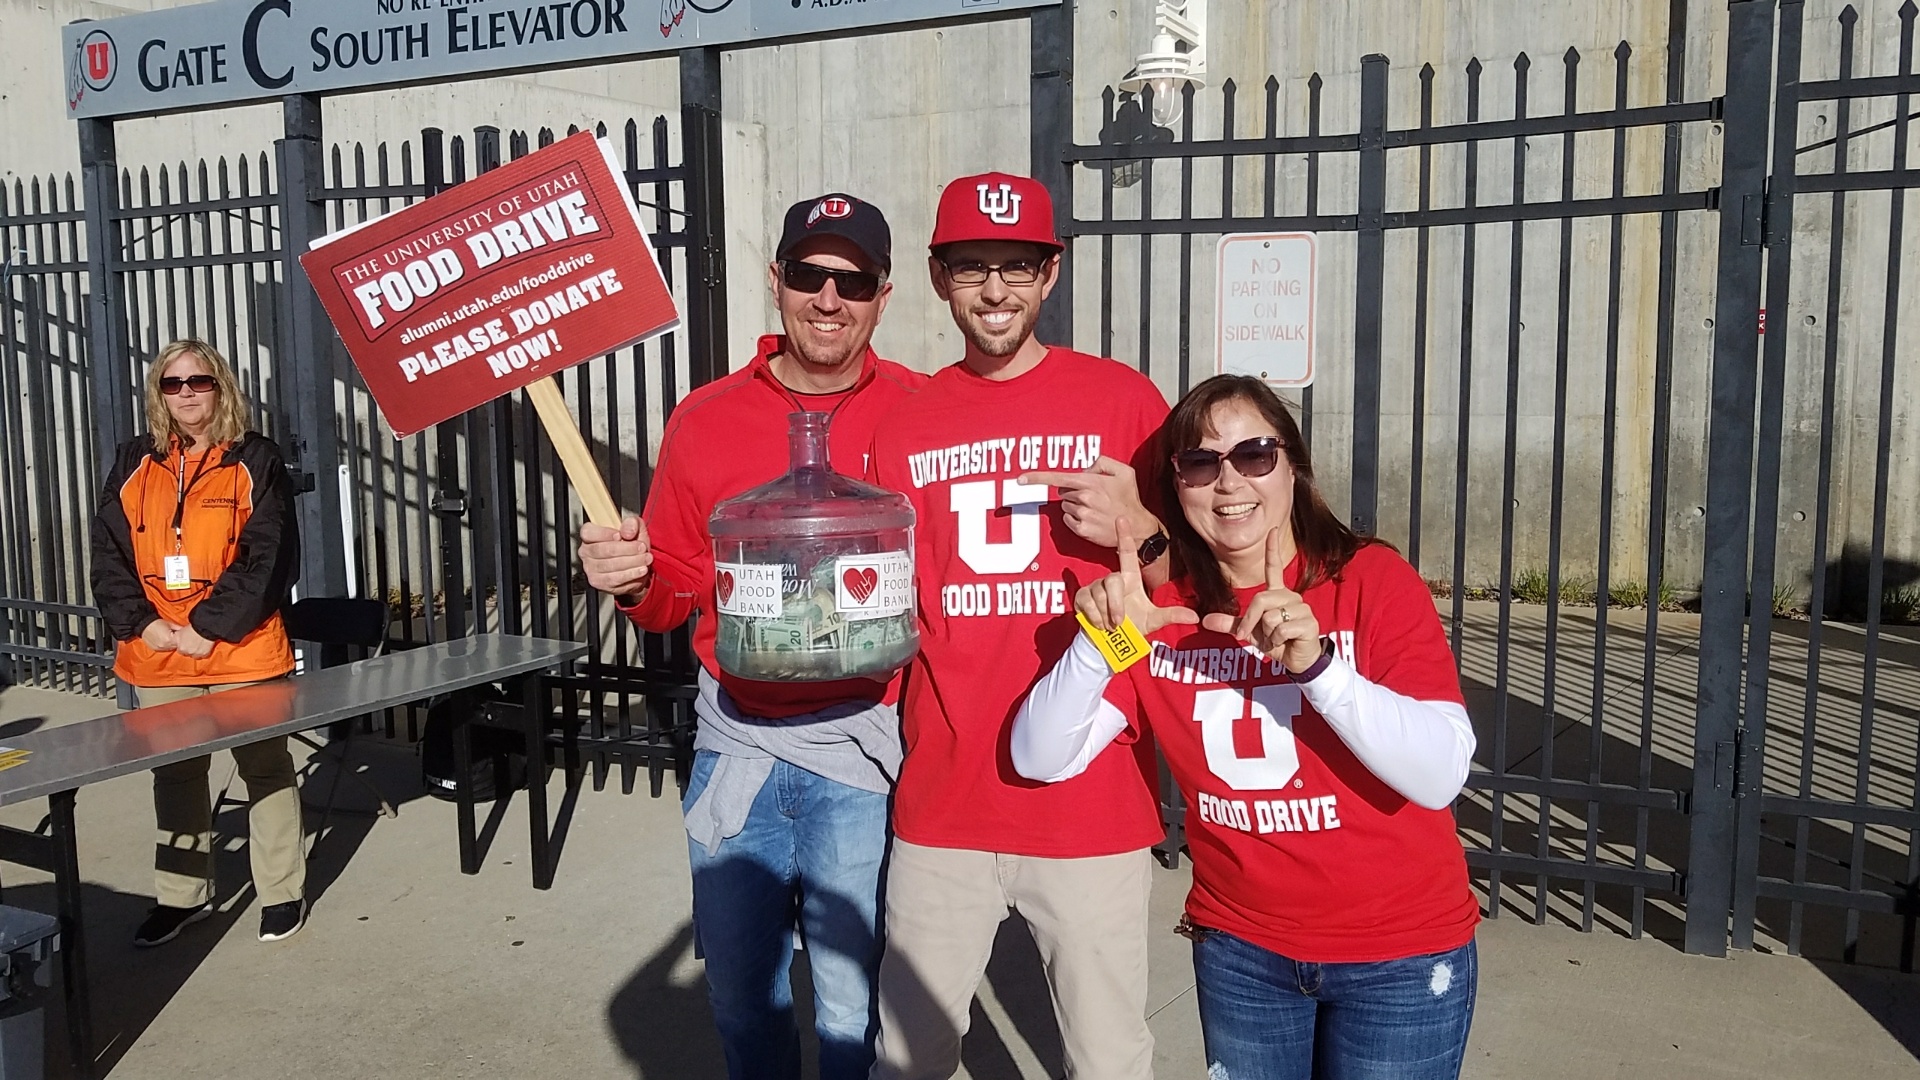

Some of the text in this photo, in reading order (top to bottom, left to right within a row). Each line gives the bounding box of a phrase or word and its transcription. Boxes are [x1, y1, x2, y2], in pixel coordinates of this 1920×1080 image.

[138, 0, 628, 92] GATE C SOUTH ELEVATOR
[340, 171, 580, 285] THE UNIVERSITY OF UTAH
[353, 190, 601, 330] FOOD DRIVE
[1252, 258, 1281, 274] NO
[399, 252, 595, 346] alumni.utah.edu/fooddrive
[1231, 280, 1301, 297] PARKING
[1254, 303, 1277, 318] ON
[398, 268, 624, 383] PLEASE DONATE
[1225, 325, 1305, 341] SIDEWALK
[485, 328, 563, 379] NOW!
[907, 437, 1016, 489] UNIVERSITY
[1019, 435, 1043, 470] OF
[1046, 434, 1101, 470] UTAH
[950, 479, 1048, 575] U
[739, 568, 775, 581] UTAH
[883, 562, 909, 575] UTAH
[740, 585, 775, 598] FOOD
[884, 578, 909, 591] FOOD
[996, 581, 1065, 616] DRIVE
[740, 601, 775, 615] BANK
[884, 595, 909, 608] BANK
[826, 612, 841, 626] 10
[790, 630, 801, 645] 20
[1104, 628, 1131, 657] NGER
[1149, 640, 1265, 684] UNIVERSITY
[1193, 683, 1301, 790] U
[1198, 792, 1341, 834] FOOD DRIVE
